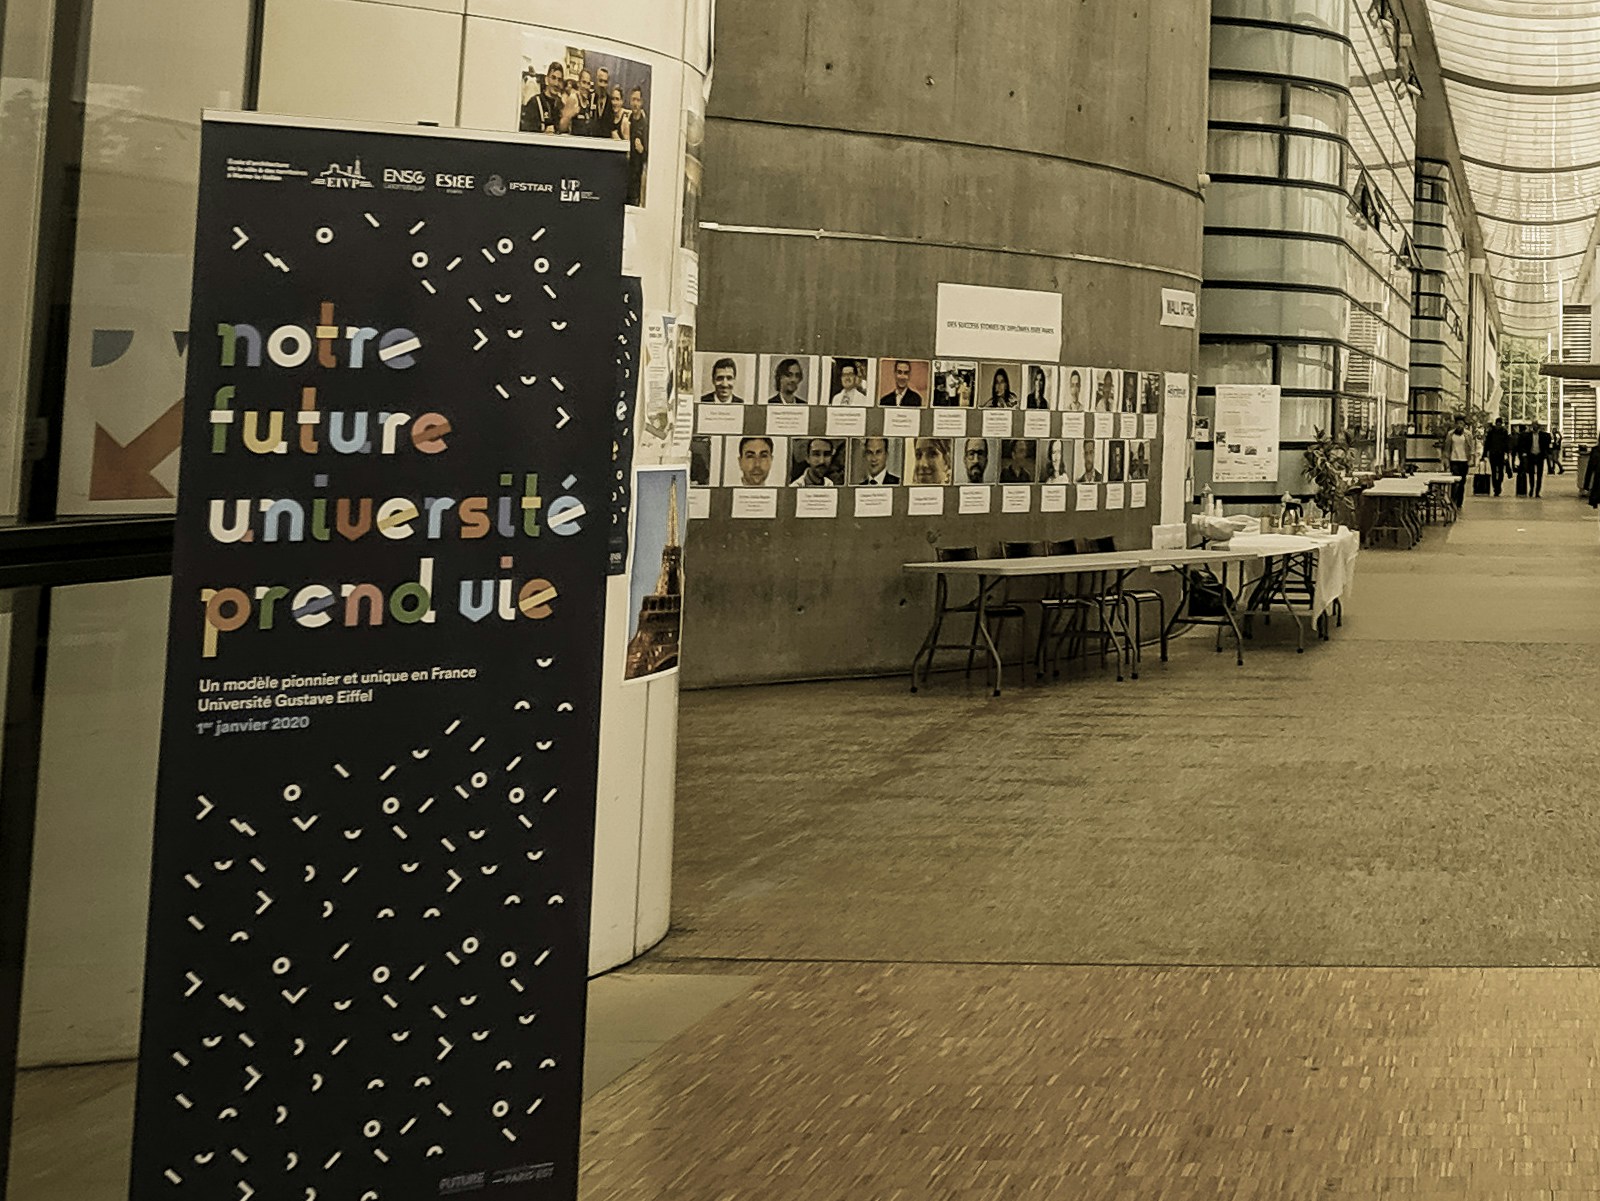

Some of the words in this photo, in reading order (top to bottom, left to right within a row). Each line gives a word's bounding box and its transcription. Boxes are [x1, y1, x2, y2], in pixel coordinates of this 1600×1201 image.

[383, 168, 427, 185] ENSG
[435, 173, 476, 189] ESIEE
[509, 181, 554, 193] IFSTTAR
[217, 302, 422, 369] notre
[210, 385, 452, 455] future
[208, 473, 587, 543] université
[201, 557, 436, 658] prend
[459, 556, 558, 622] vie
[199, 679, 220, 693] Un
[223, 675, 278, 692] modèle
[281, 673, 340, 691] pionnier
[343, 672, 358, 685] et
[361, 669, 408, 686] unique
[411, 670, 428, 682] en
[431, 666, 477, 680] France
[197, 694, 272, 712] Université
[275, 691, 334, 708] Gustave
[336, 689, 373, 704] Eiffel
[214, 716, 270, 737] janvier
[271, 715, 310, 730] 2020
